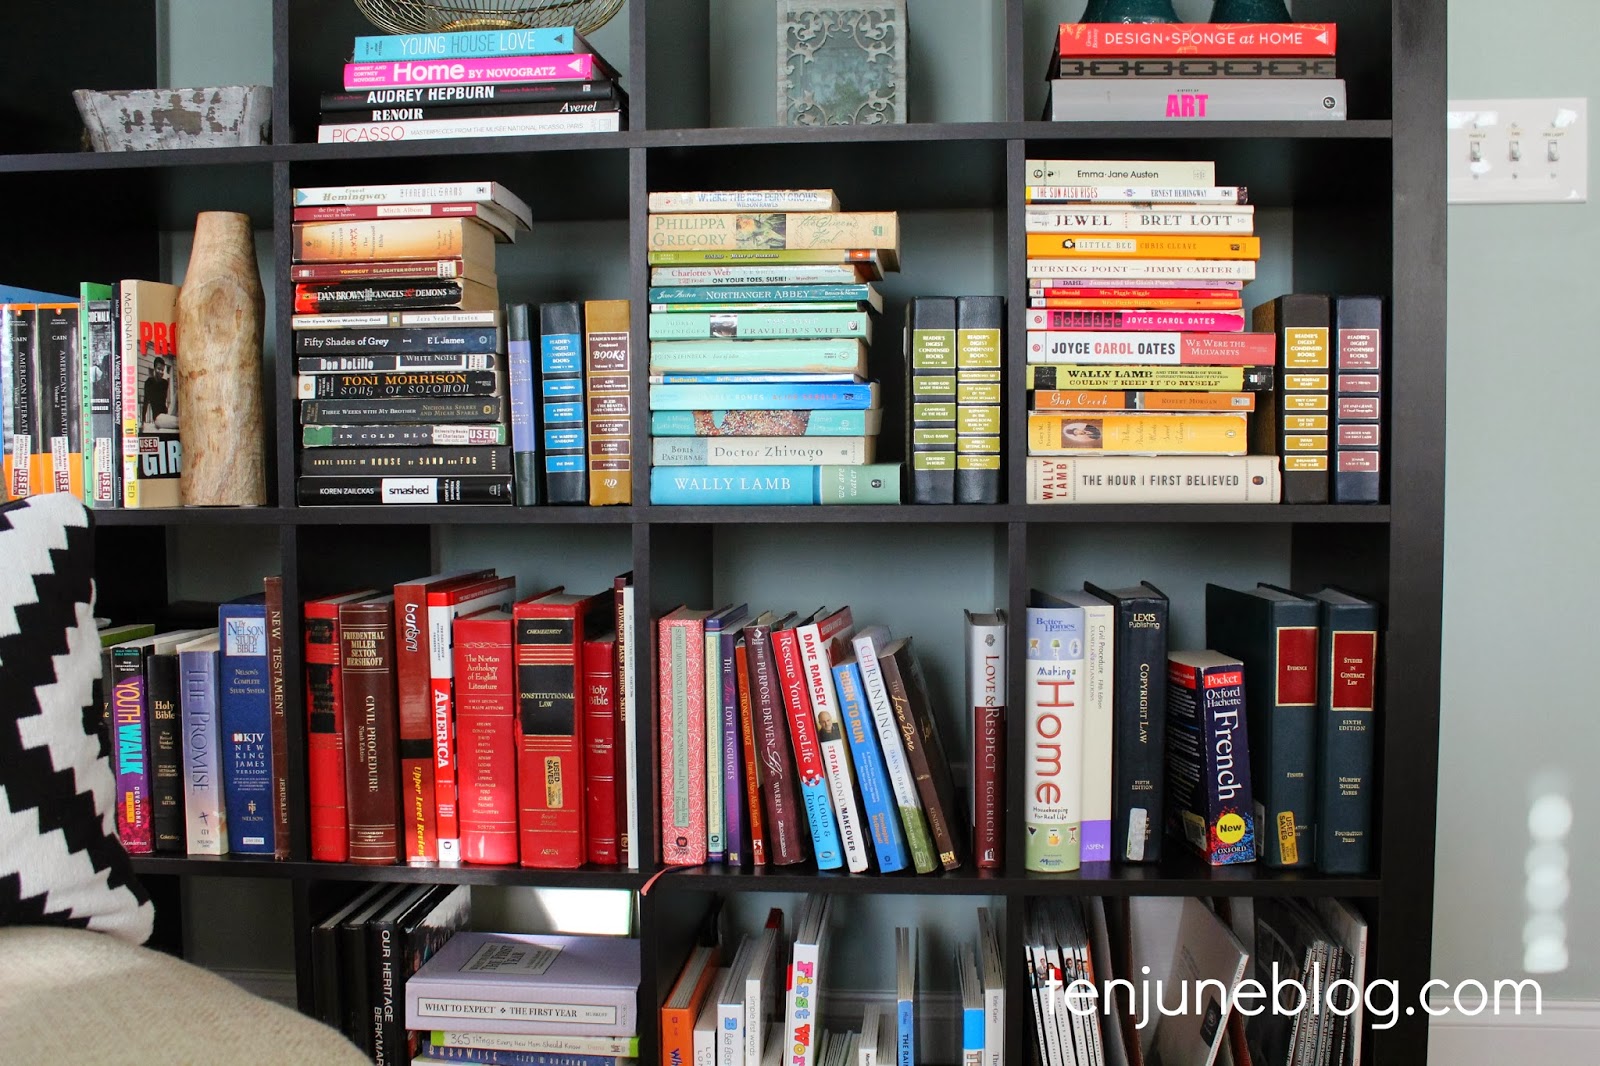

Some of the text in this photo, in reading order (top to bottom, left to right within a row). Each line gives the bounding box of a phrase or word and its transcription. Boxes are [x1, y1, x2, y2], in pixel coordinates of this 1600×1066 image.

[400, 31, 535, 55] YOUNG HOUSE LOVE
[1240, 34, 1254, 44] at
[1259, 33, 1303, 44] HOME
[394, 64, 556, 82] Home BY NOVOGRATZ
[367, 89, 422, 103] AUDREY
[428, 86, 494, 100] HEPBURN
[560, 102, 597, 113] Avenel
[1166, 95, 1208, 117] ART
[372, 108, 423, 121] RENOIR
[332, 125, 404, 143] PICASSO
[1130, 170, 1158, 178] Austen
[323, 192, 387, 201] Hemingway
[1037, 187, 1097, 198] THE SUN ALSO RISES
[1151, 189, 1207, 197] ERNEST HEMINGWAY
[656, 217, 725, 230] PHILIPPA
[1054, 215, 1232, 227] JEWEL BRET LOTT
[653, 233, 727, 246] GREGORY
[318, 291, 335, 300] DAN
[336, 291, 364, 300] BROWN
[374, 290, 403, 298] ANGELS
[706, 290, 810, 299] NORTHANGER ABBEY
[124, 293, 132, 350] McDONALD
[304, 337, 389, 346] Fifty Shades of Grey
[1052, 343, 1175, 354] JOYCE CAROL OATES
[321, 359, 373, 370] Don DeLillo
[343, 375, 466, 385] TONI MORRISON
[1050, 393, 1108, 405] Gap Creek
[469, 430, 495, 439] USED
[662, 453, 703, 461] PASTERNAK
[715, 446, 823, 461] Doctor Zhivago
[675, 478, 791, 489] WALLY LAMB
[1043, 460, 1054, 500] WALLY
[1057, 463, 1067, 496] LAMB
[1083, 476, 1102, 485] THE
[1108, 476, 1136, 485] HOUR
[1150, 475, 1181, 485] FIRST
[1187, 476, 1239, 486] BELIEVED
[389, 486, 429, 495] smashed
[839, 485, 845, 498] we
[405, 603, 420, 651] barbri
[1129, 621, 1160, 629] Publishing
[343, 631, 385, 640] FRIEDENTHAL
[351, 640, 376, 648] MILLER
[351, 649, 376, 657] SEXTON
[464, 655, 477, 663] The
[272, 611, 284, 716] NEW TESTAMENT
[467, 664, 498, 673] Anthology
[804, 633, 826, 706] DAVE RAMSEY
[476, 673, 497, 682] English
[757, 662, 770, 704] PURPOSE
[1207, 675, 1238, 686] Pocket
[861, 646, 893, 740] CHIRUNNING
[1206, 688, 1240, 699] Oxford
[155, 701, 174, 711] Holy
[780, 637, 812, 763] Rescue Your LoveLife
[1140, 664, 1149, 744] COPYRIGHT LAW
[1207, 698, 1241, 707] Hachette
[156, 710, 175, 720] Bible
[725, 706, 733, 726] LOVE
[116, 682, 143, 776] YOUTH WALK
[188, 670, 210, 791] THE PROMISE
[435, 690, 449, 768] AMERICA
[763, 707, 774, 747] DRIVEN
[366, 696, 378, 792] CIVIL PROCEDURE
[1036, 681, 1075, 805] Home
[726, 731, 735, 779] LANGUAGES
[1213, 710, 1243, 801] French
[279, 778, 287, 824] JERUSALEM
[773, 782, 782, 814] WARREN
[1033, 806, 1068, 814] Housekeeping
[806, 792, 820, 842] TOWNSEND
[1220, 824, 1242, 833] New
[1217, 846, 1246, 854] OXFORD
[382, 930, 393, 1021] OUR HERITAGE
[796, 961, 813, 1019] First
[425, 1004, 577, 1017] WHAT TO EXPECT THE FIRST YEAR
